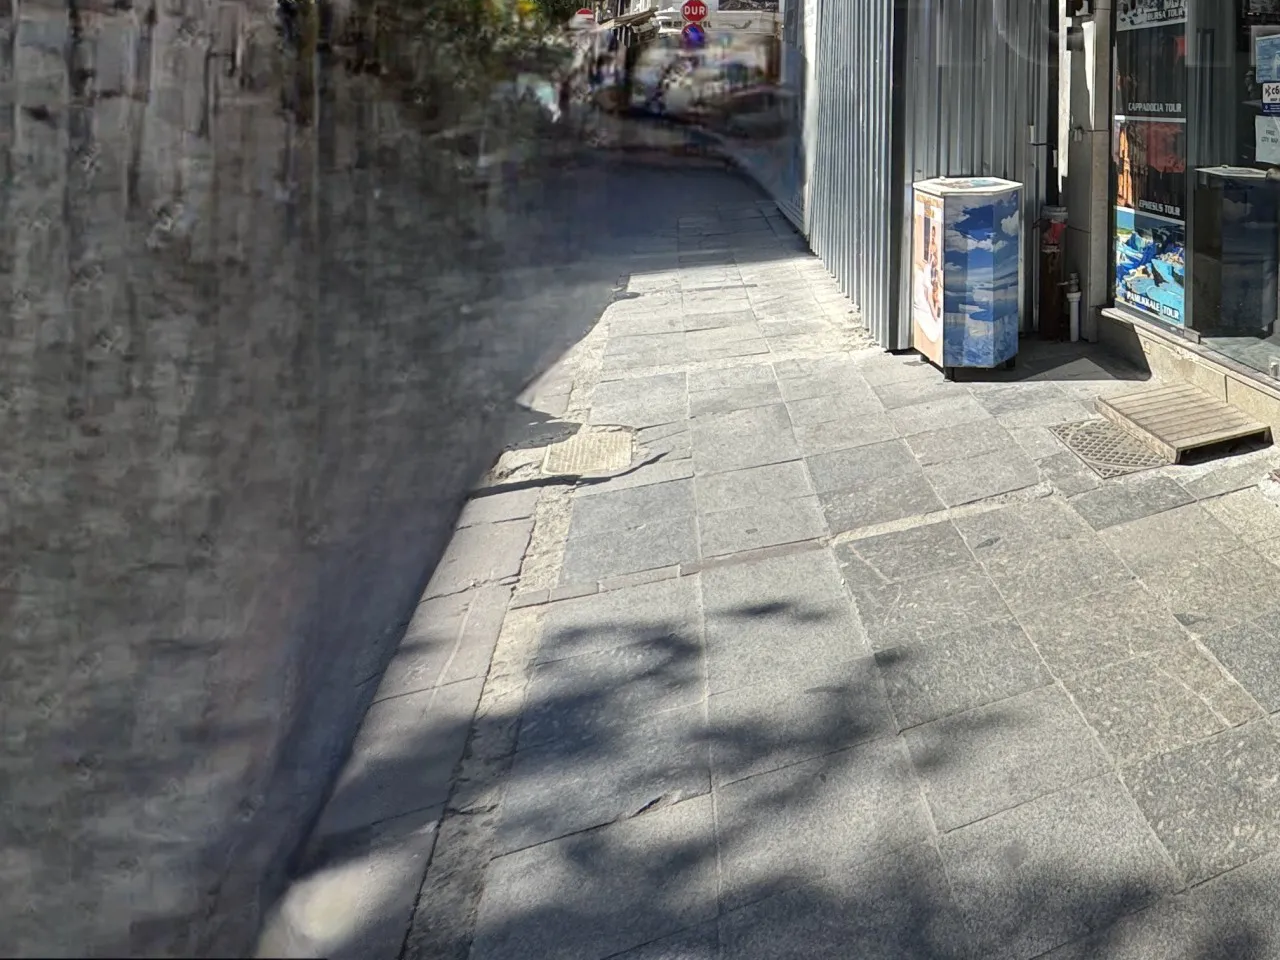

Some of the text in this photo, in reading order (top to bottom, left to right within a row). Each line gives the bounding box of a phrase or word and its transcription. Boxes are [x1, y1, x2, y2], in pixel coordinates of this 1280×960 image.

[684, 5, 705, 16] DUR
[1126, 290, 1180, 320] PAMUKKALE TOUR
